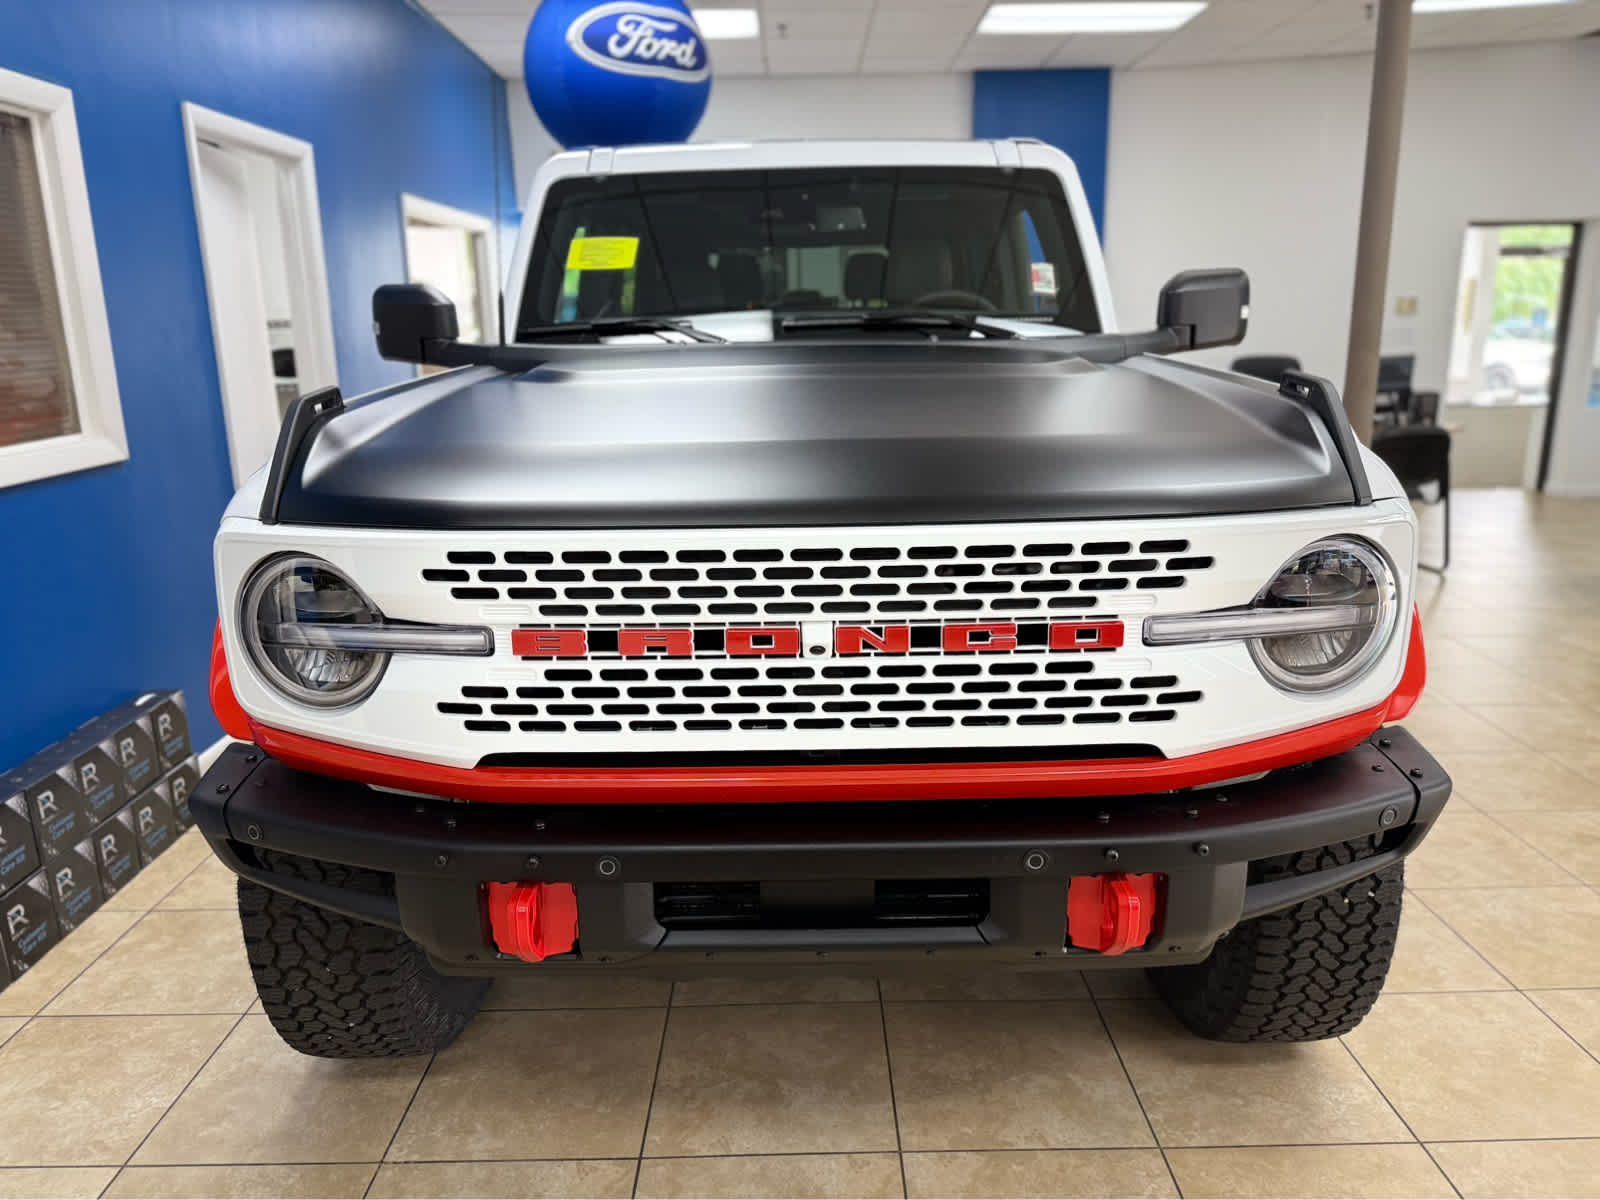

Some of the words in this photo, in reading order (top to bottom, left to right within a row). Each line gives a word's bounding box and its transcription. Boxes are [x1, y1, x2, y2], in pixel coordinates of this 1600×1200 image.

[607, 14, 697, 68] Ford
[512, 620, 1124, 657] BRONCO
[157, 713, 173, 737] R
[120, 736, 137, 763] R
[81, 761, 100, 790] R
[37, 790, 58, 819] R
[172, 777, 187, 804] R
[139, 806, 155, 832] R
[100, 833, 118, 864] R
[56, 867, 75, 897] R
[7, 904, 29, 935] R
